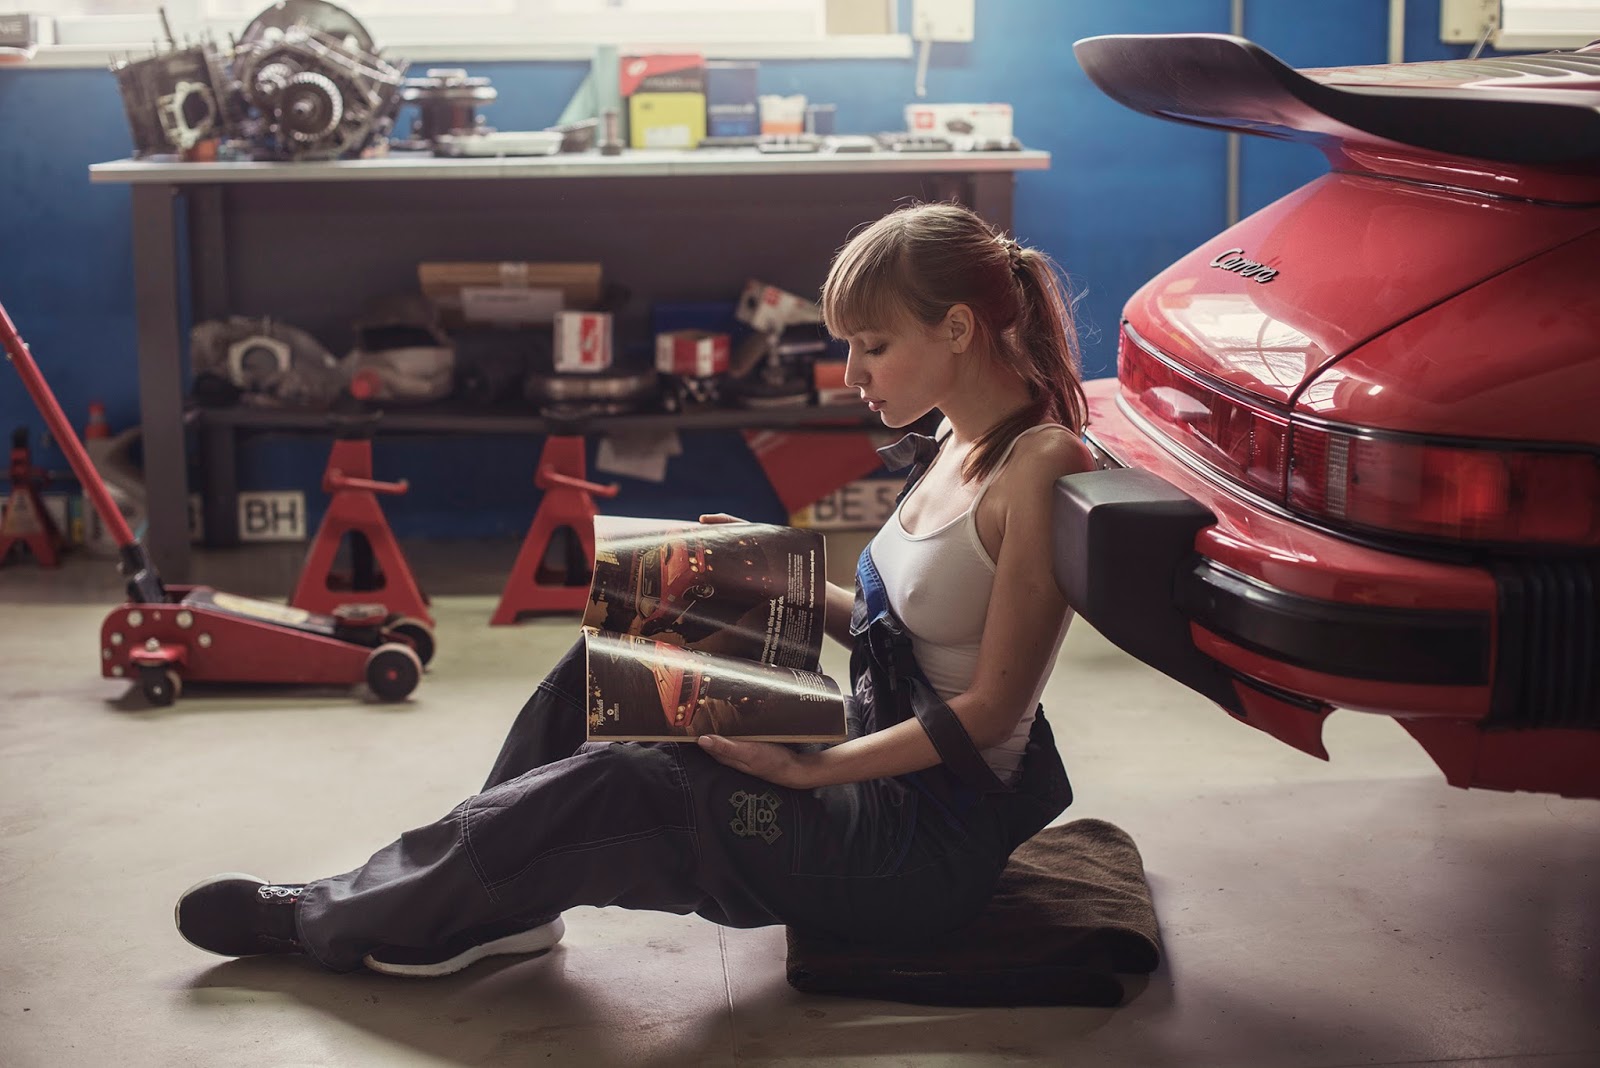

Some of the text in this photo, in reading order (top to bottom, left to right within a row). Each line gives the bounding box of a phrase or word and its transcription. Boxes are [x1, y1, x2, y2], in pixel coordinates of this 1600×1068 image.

[1210, 247, 1279, 283] Carrera
[245, 498, 297, 533] BH
[815, 486, 864, 520] BE
[756, 807, 773, 823] 8
